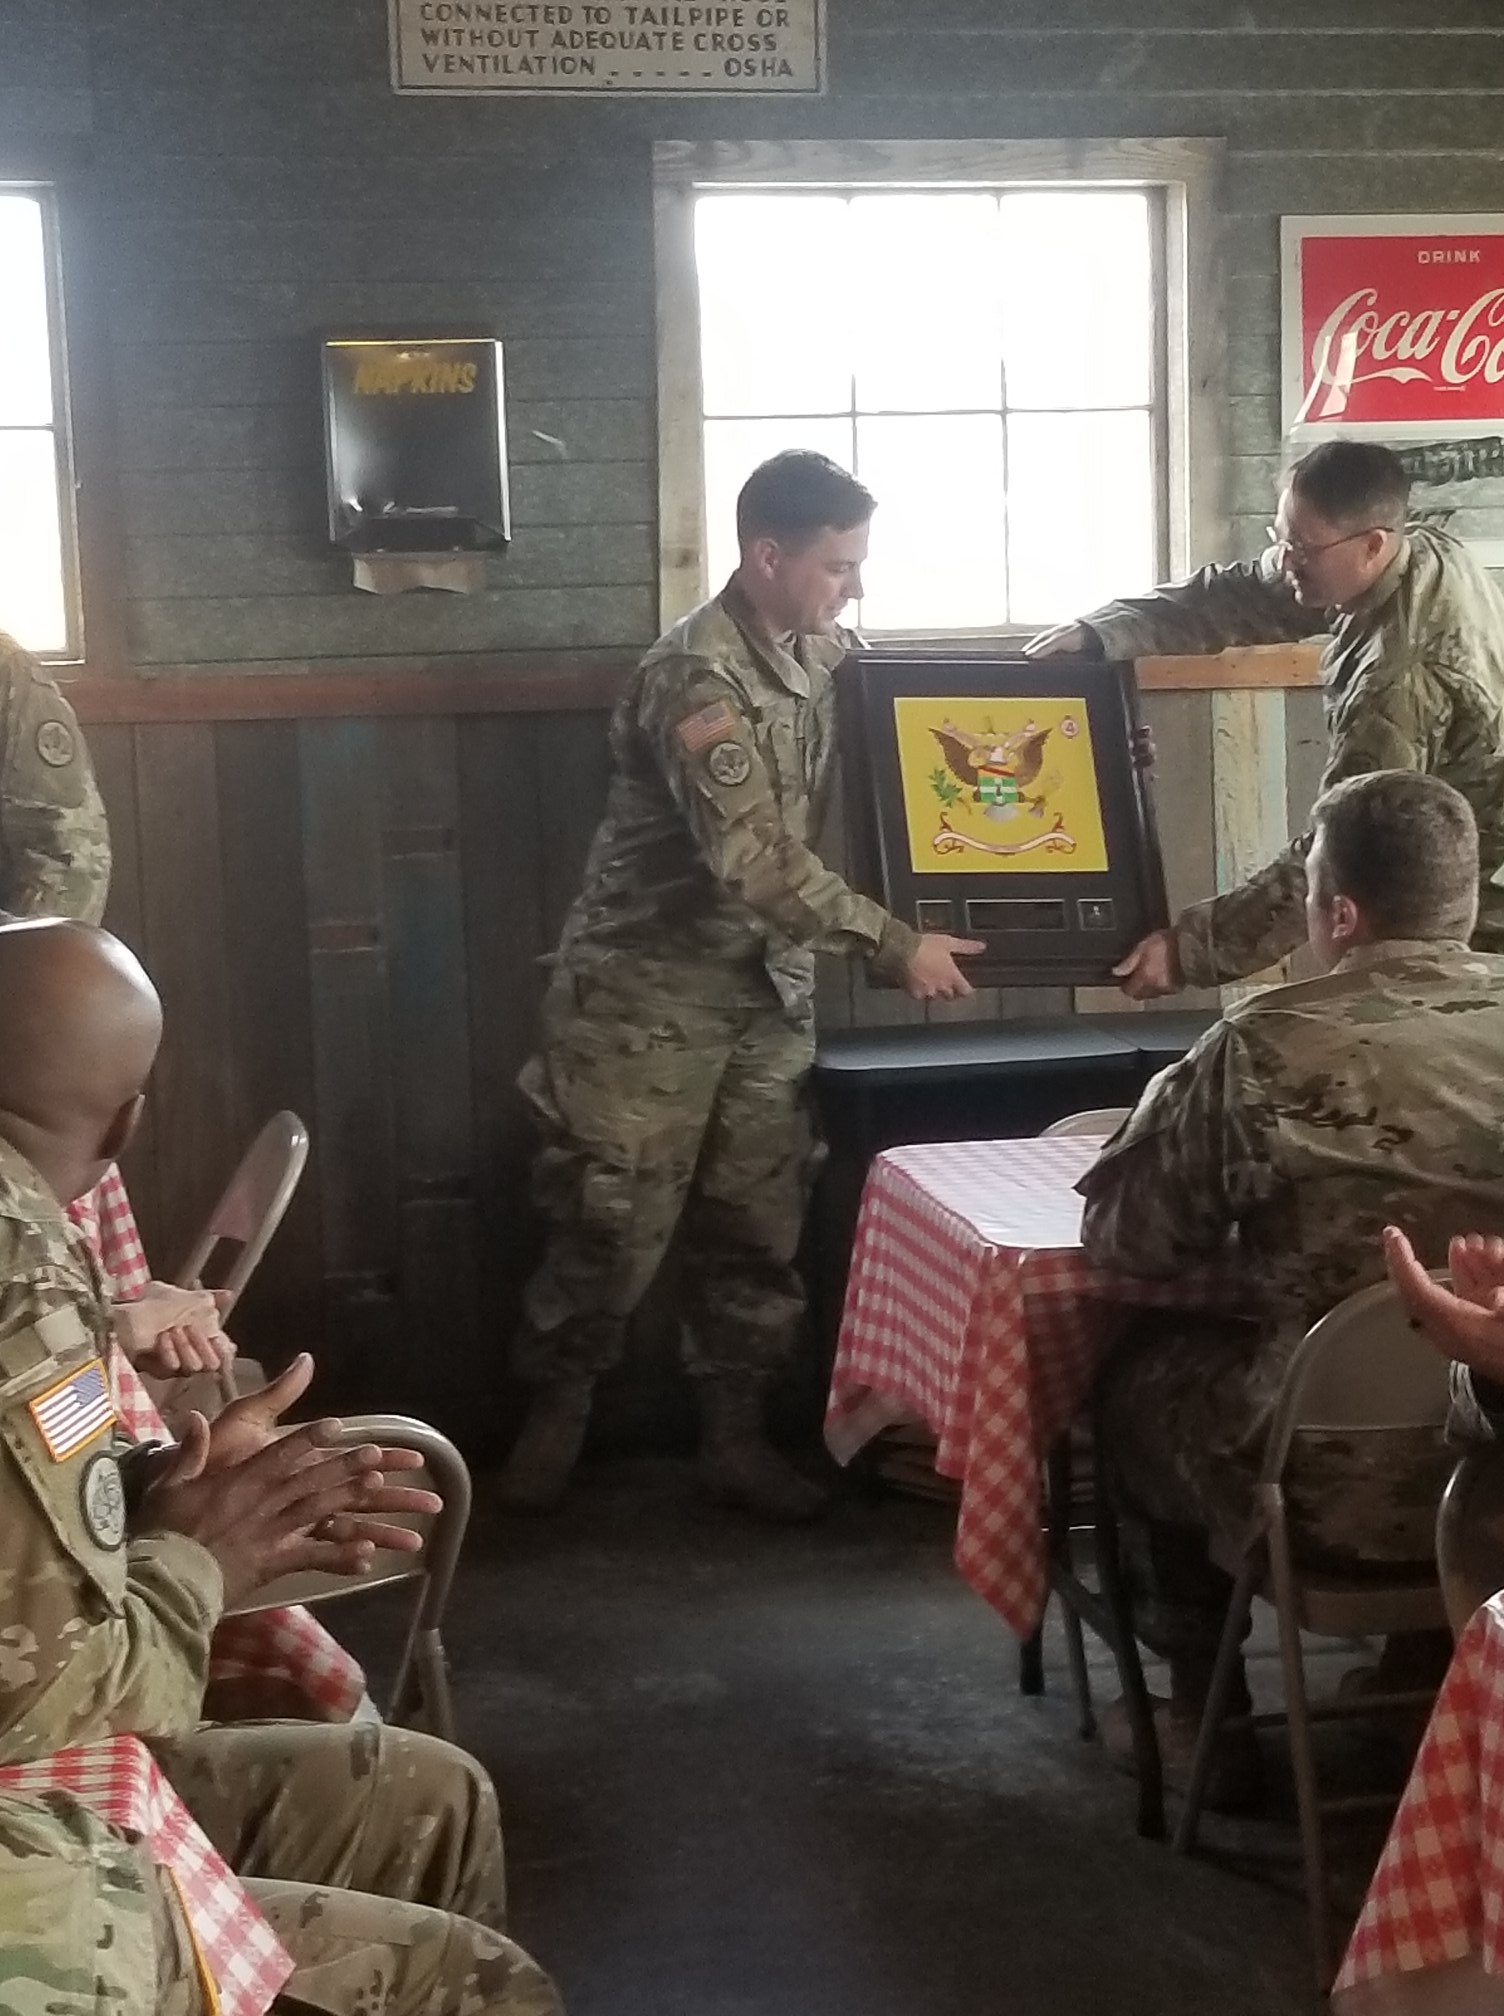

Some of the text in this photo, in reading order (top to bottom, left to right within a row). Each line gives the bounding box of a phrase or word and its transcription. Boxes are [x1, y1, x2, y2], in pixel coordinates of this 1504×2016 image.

[420, 2, 790, 28] CONNECTED TO TAILPIPE OR
[421, 28, 778, 52] WITHOUT ADEQUATE CROSS
[422, 53, 793, 78] VENTILATION OSHA
[1417, 249, 1481, 264] DRINK
